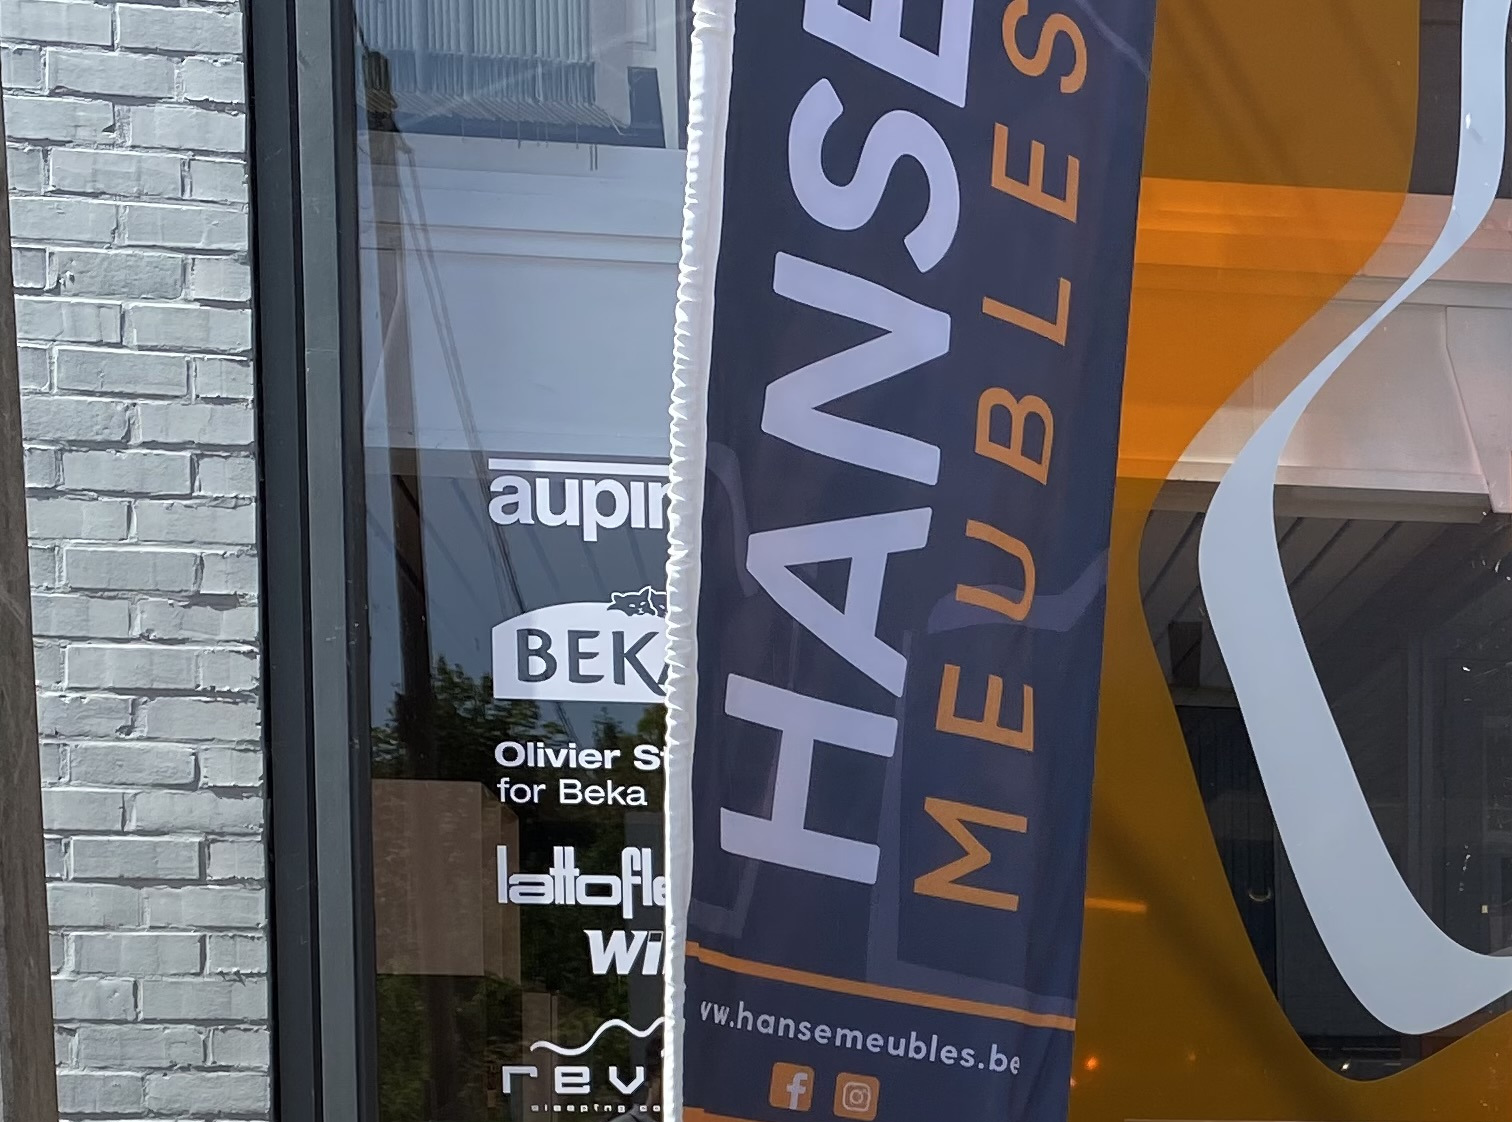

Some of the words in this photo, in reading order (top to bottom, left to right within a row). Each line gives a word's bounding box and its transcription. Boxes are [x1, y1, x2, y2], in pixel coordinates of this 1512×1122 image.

[720, 0, 974, 884] HANSE
[913, 0, 1088, 912] MEUBLES
[516, 628, 668, 697] BEK
[495, 741, 621, 769] Olivier
[633, 744, 666, 771] S
[497, 777, 547, 803] for
[559, 779, 648, 806] Beka
[583, 929, 666, 976] Wi
